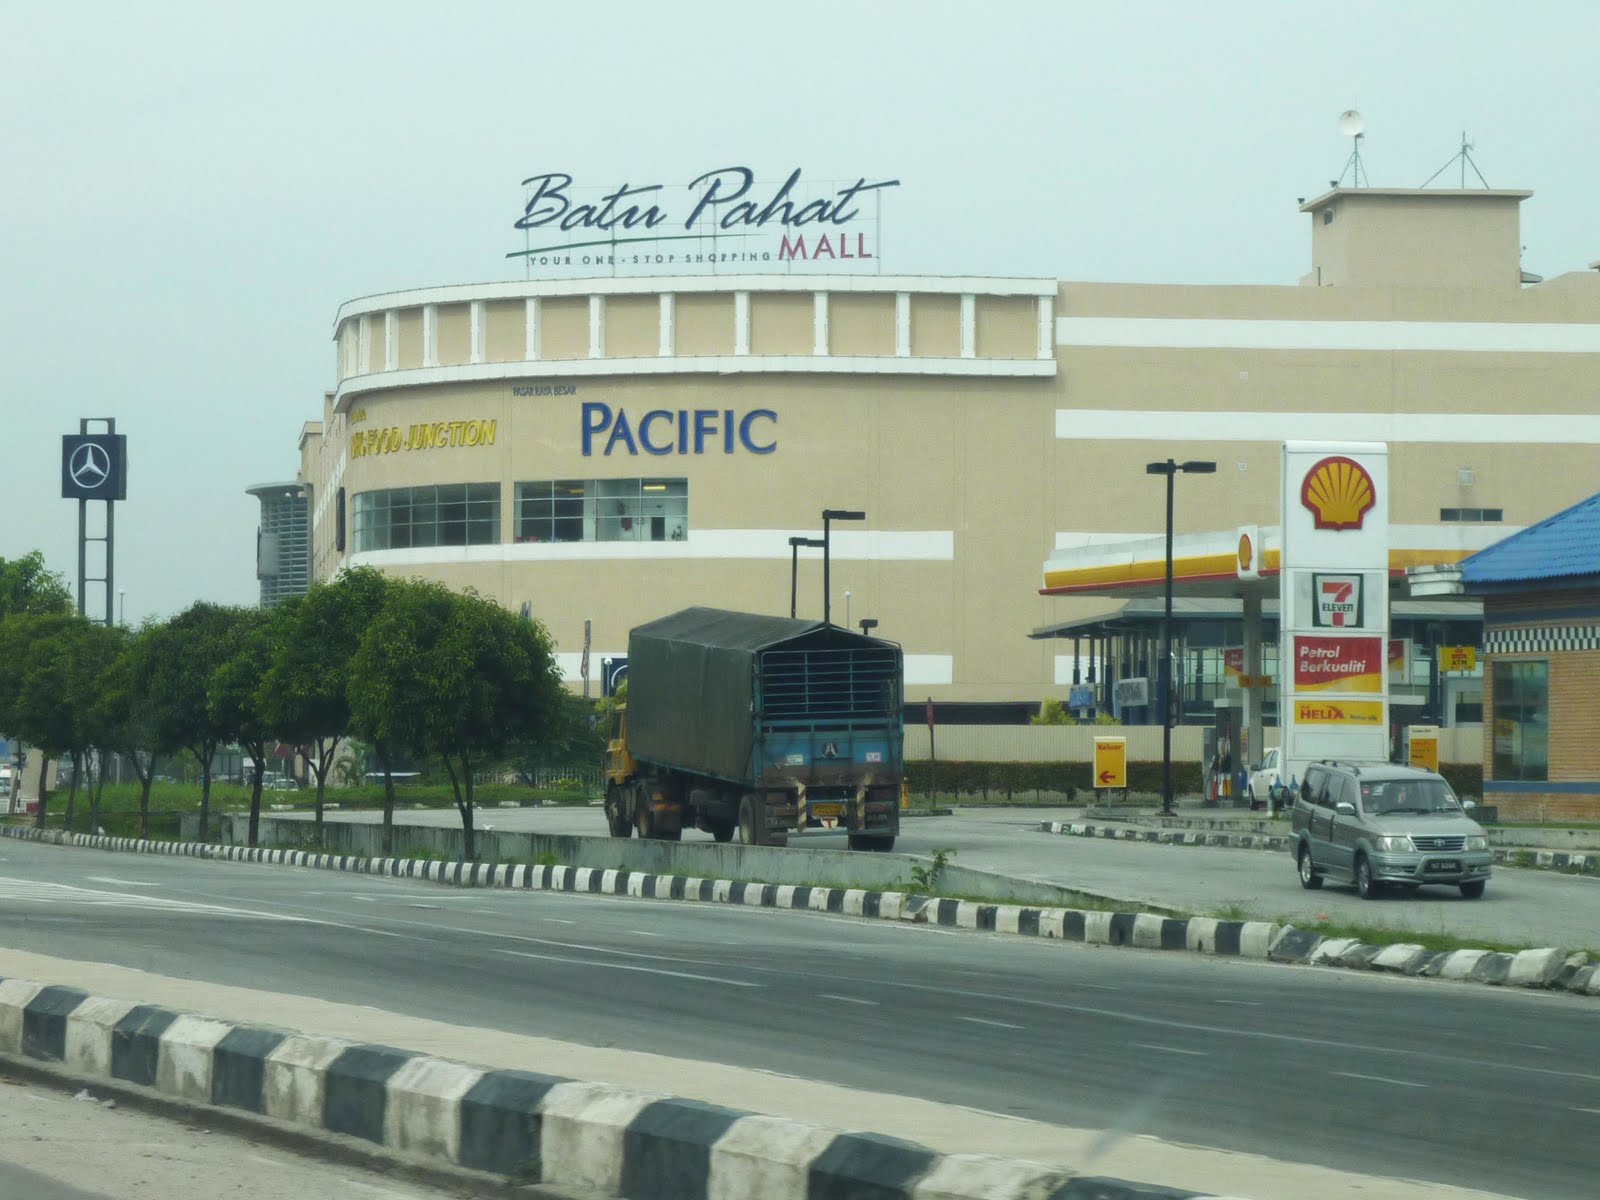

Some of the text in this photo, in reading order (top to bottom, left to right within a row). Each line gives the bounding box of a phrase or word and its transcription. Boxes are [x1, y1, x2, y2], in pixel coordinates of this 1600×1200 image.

[513, 166, 901, 231] Batu Pahat
[777, 232, 873, 261] MALL
[529, 256, 572, 266] YOUR
[684, 251, 771, 264] SHOPPING
[404, 419, 496, 451] JUNCTION
[581, 402, 778, 457] PACIFIC
[1300, 645, 1340, 658] Petrol
[1300, 659, 1366, 673] Berkualiti
[1300, 706, 1344, 720] HELIX
[1098, 743, 1122, 751] Keluar
